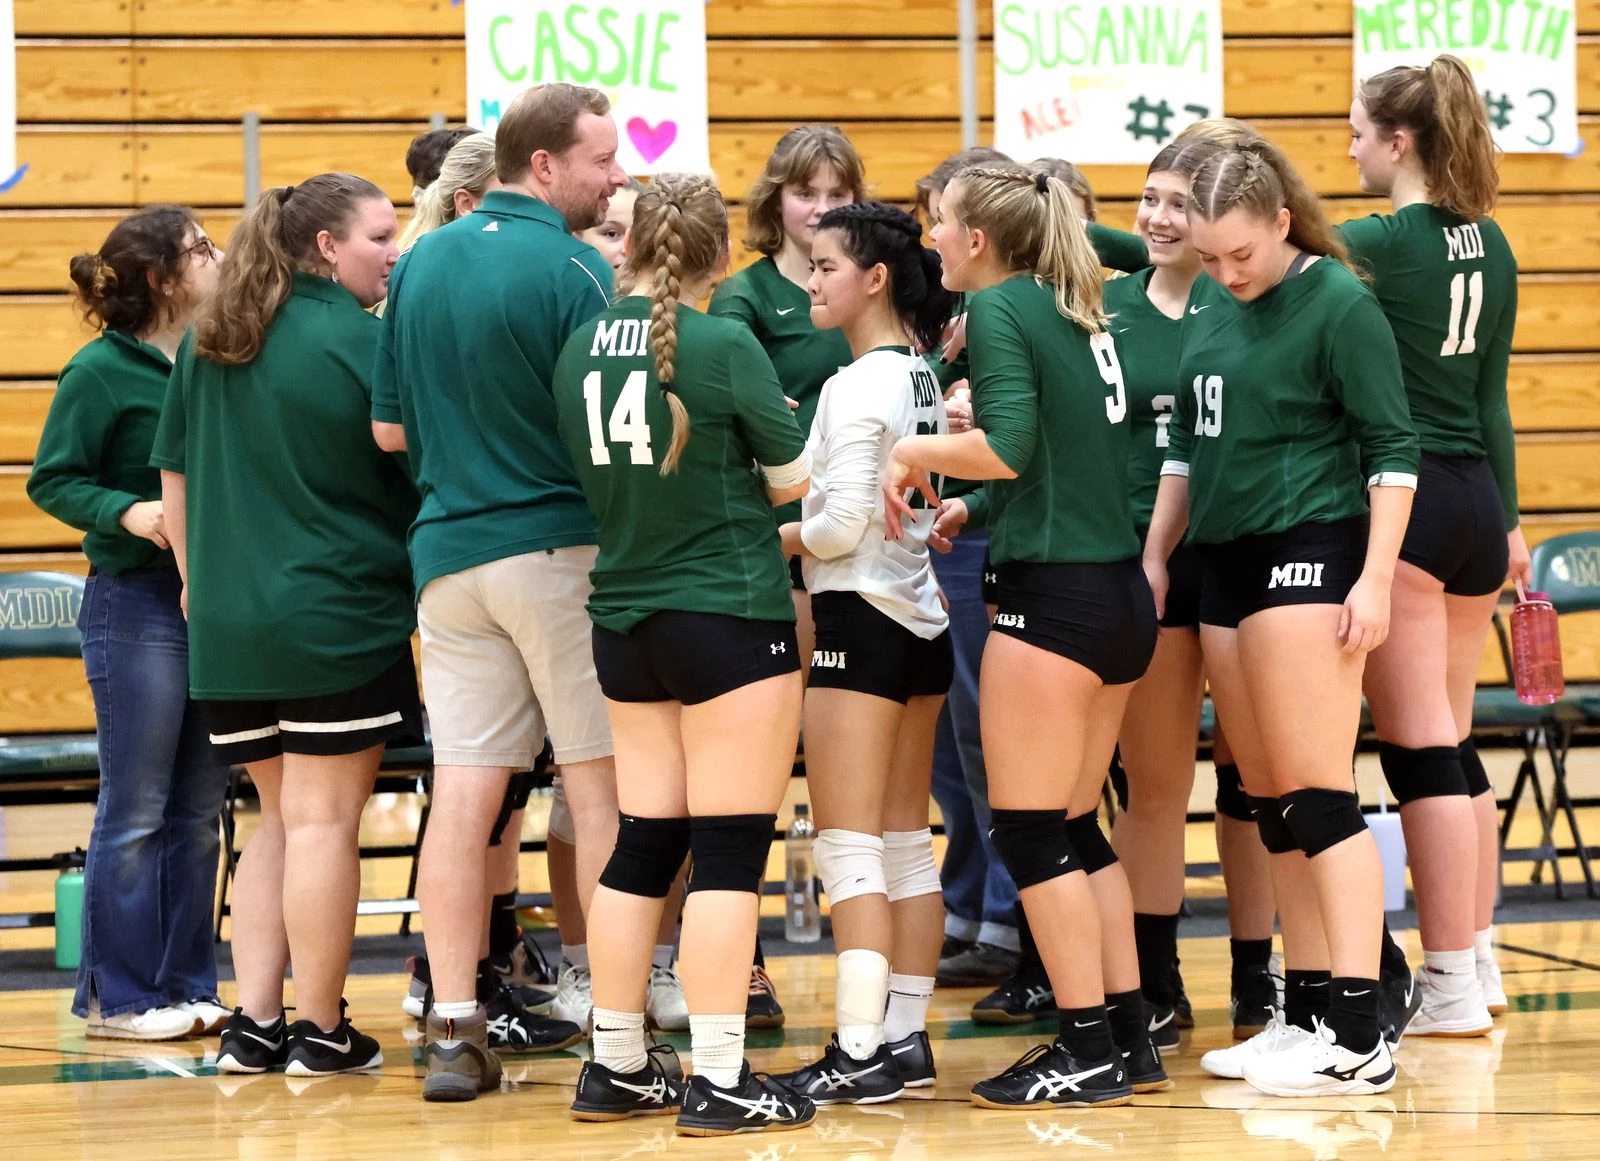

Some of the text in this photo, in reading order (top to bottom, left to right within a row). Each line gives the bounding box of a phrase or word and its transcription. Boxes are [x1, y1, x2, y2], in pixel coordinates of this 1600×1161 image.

[488, 4, 680, 92] CASSIE
[997, 3, 1209, 76] SUSANNA
[1357, 0, 1571, 61] MEREDITH
[1442, 222, 1485, 261] MDI
[589, 318, 652, 356] MDI
[1440, 271, 1483, 357] 11
[910, 370, 936, 408] MDI
[1089, 331, 1127, 425] 9
[1193, 374, 1224, 438] 19
[583, 370, 654, 466] 14
[1267, 562, 1325, 589] MDI
[0, 586, 76, 630] MDI
[811, 650, 847, 669] MDI
